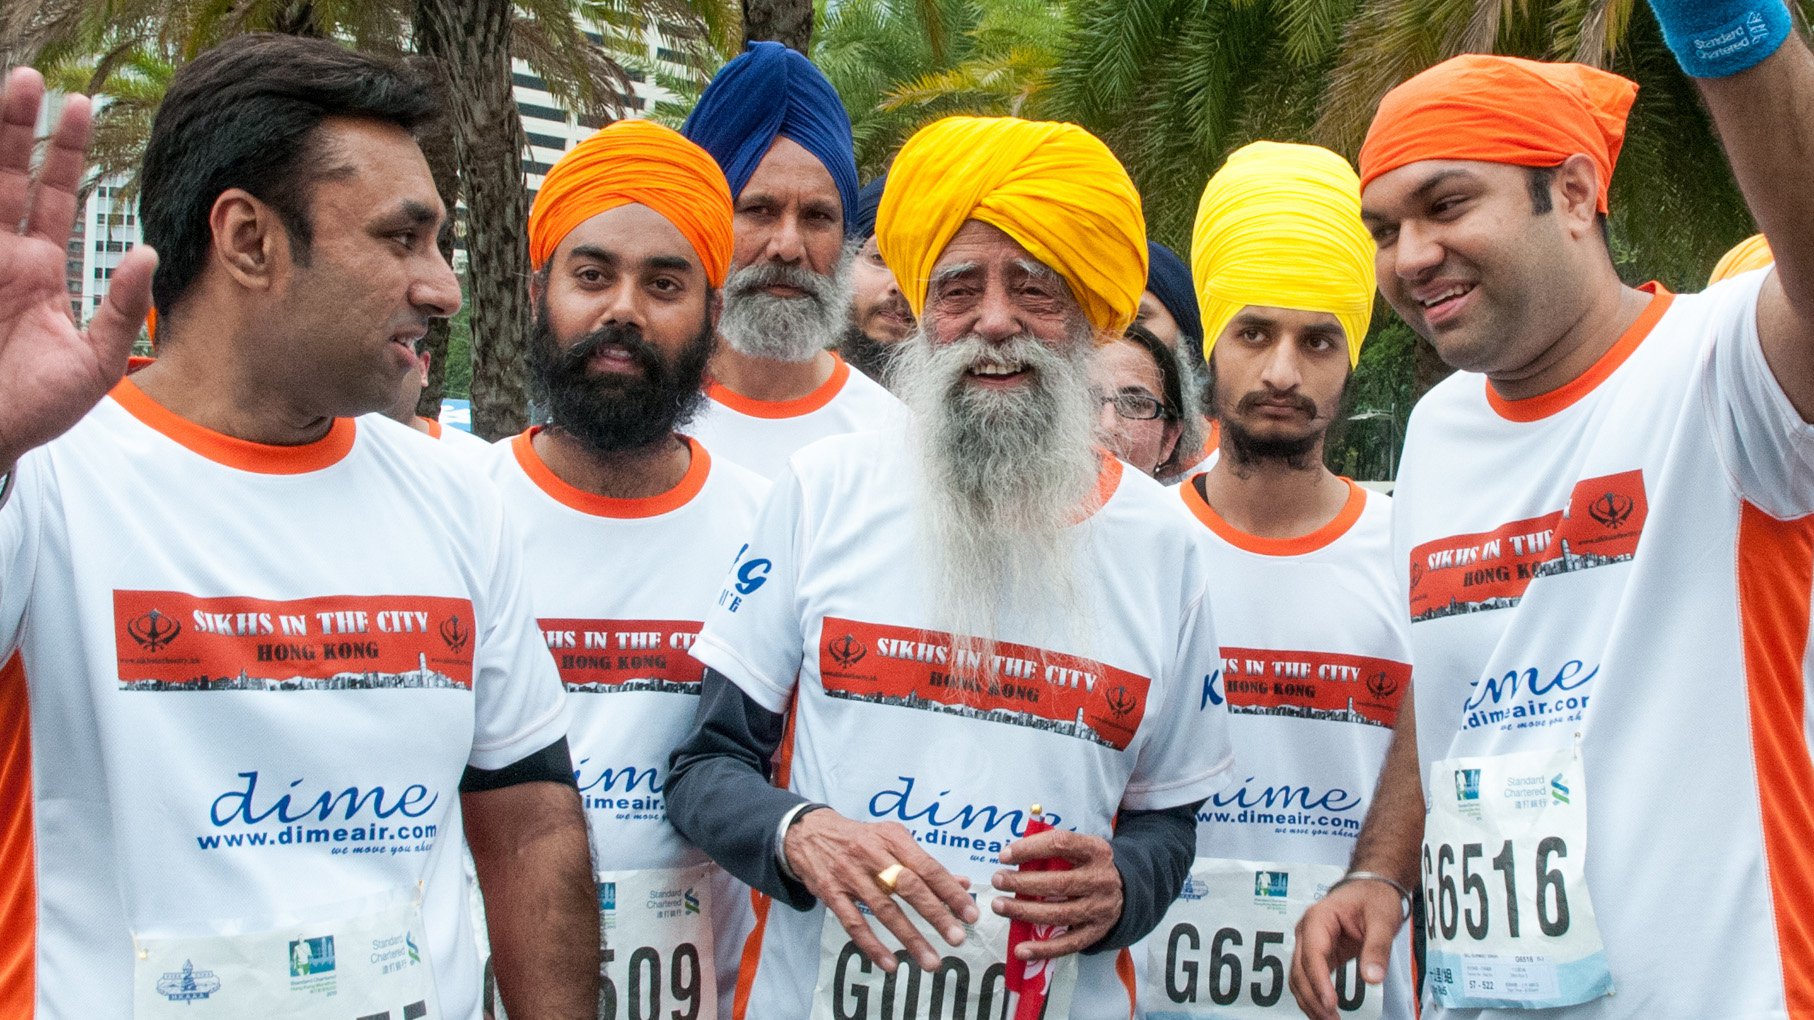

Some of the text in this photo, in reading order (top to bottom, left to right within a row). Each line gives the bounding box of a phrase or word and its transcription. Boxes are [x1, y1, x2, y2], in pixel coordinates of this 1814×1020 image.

[1694, 26, 1745, 49] Standard
[1696, 37, 1750, 60] Chartered
[1427, 546, 1479, 571] SIKHS
[1481, 538, 1501, 561] IN
[1463, 566, 1510, 588] HONG
[193, 609, 429, 637] SIKHS IN THE CITY
[584, 631, 608, 650] IN
[615, 631, 662, 650] THE
[257, 641, 379, 662] HONG KONG
[561, 655, 667, 670] HONG KONG
[877, 637, 1098, 693] SIKHS IN THE CITY
[1244, 659, 1265, 675] IN
[1272, 661, 1312, 680] THE
[1318, 663, 1361, 683] CITY
[1227, 680, 1316, 698] HONG KONG
[1507, 775, 1545, 787] Standard
[210, 771, 439, 827] dime
[1213, 776, 1361, 811] ime
[1504, 786, 1547, 798] Chartered
[1197, 811, 1360, 830] ww.dimeair.com
[197, 823, 437, 850] www.dimeair.com
[331, 846, 349, 855] we
[353, 846, 386, 854] move
[390, 845, 411, 856] you
[649, 889, 682, 899] Standard
[1423, 836, 1570, 940] G6516
[646, 899, 682, 909] Chartered
[372, 935, 403, 950] Standard
[370, 947, 405, 964] Chartered
[1165, 923, 1366, 1012] G650
